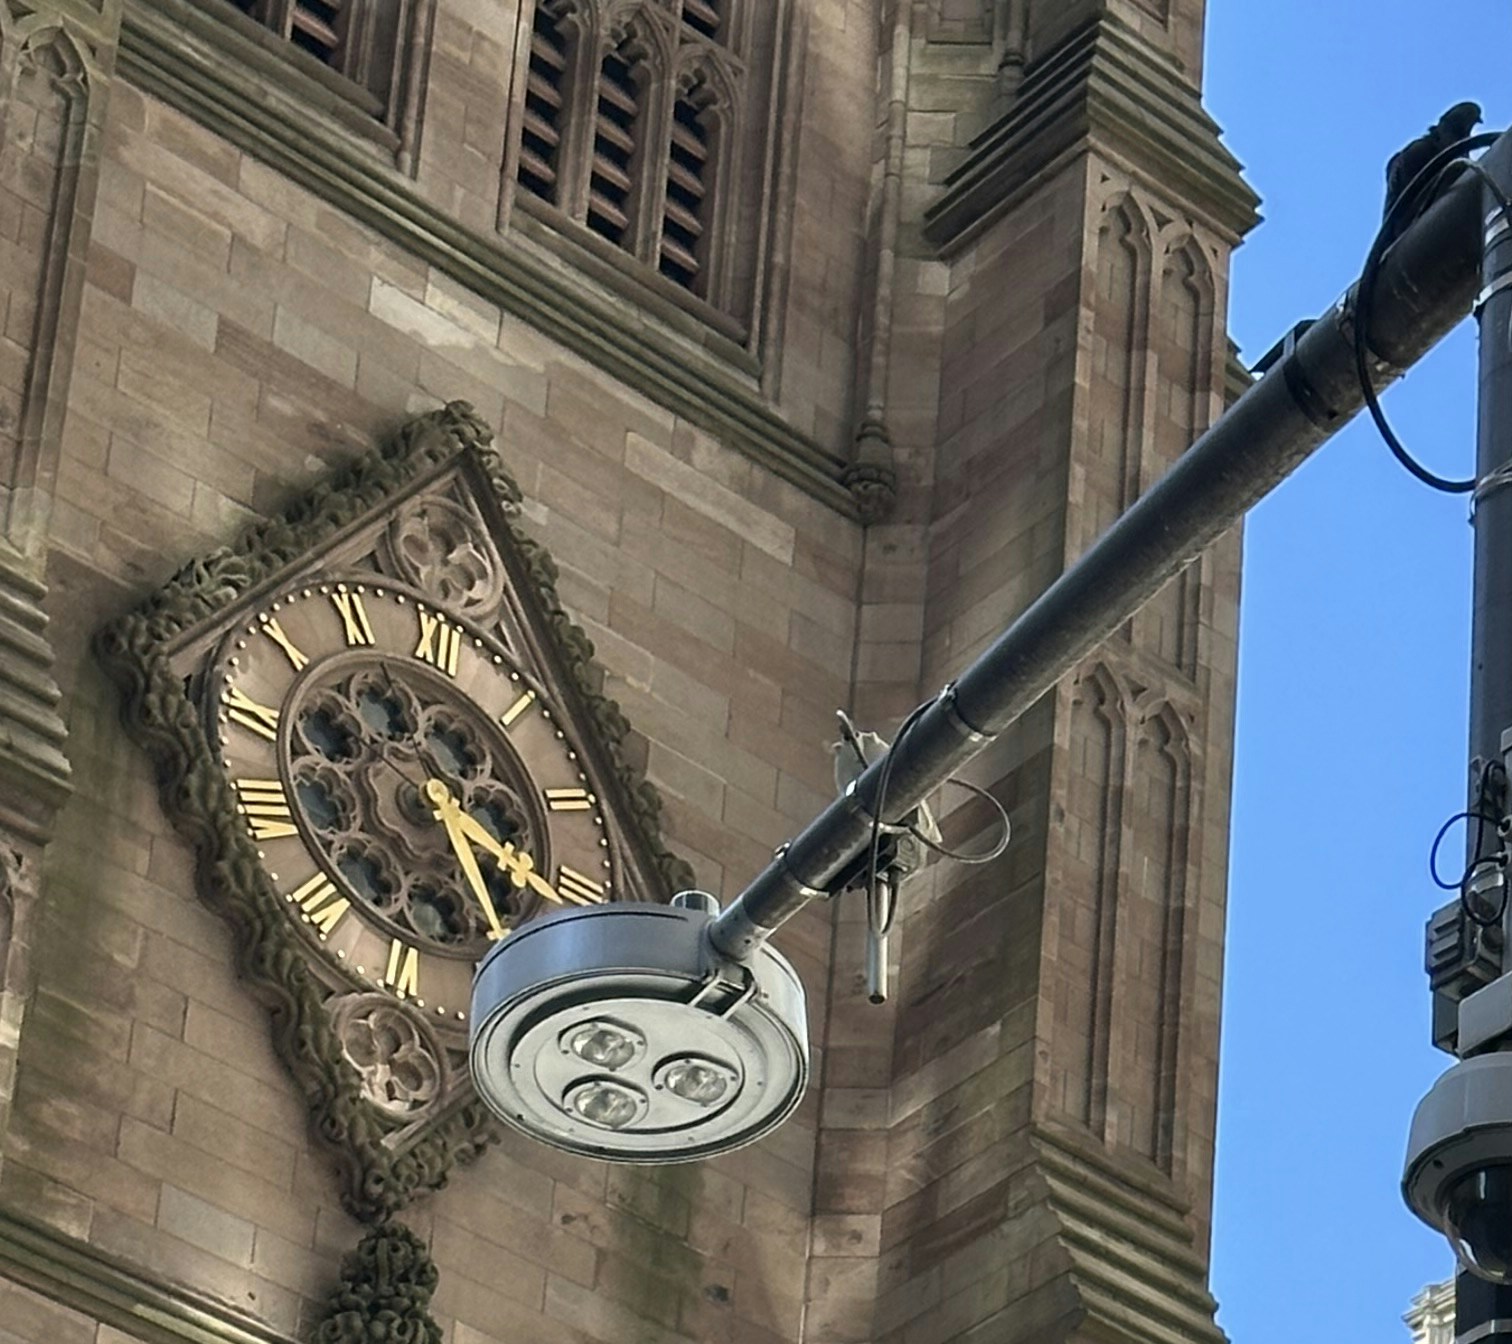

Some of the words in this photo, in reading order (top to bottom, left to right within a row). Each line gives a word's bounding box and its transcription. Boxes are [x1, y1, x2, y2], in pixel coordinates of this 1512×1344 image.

[262, 617, 310, 672] X
[331, 593, 376, 645] XI
[415, 611, 461, 678] XII
[228, 686, 280, 742] IX
[501, 693, 533, 727] I
[236, 778, 299, 841] VIII
[545, 788, 592, 811] II
[292, 871, 351, 934] VII
[385, 938, 419, 997] VI
